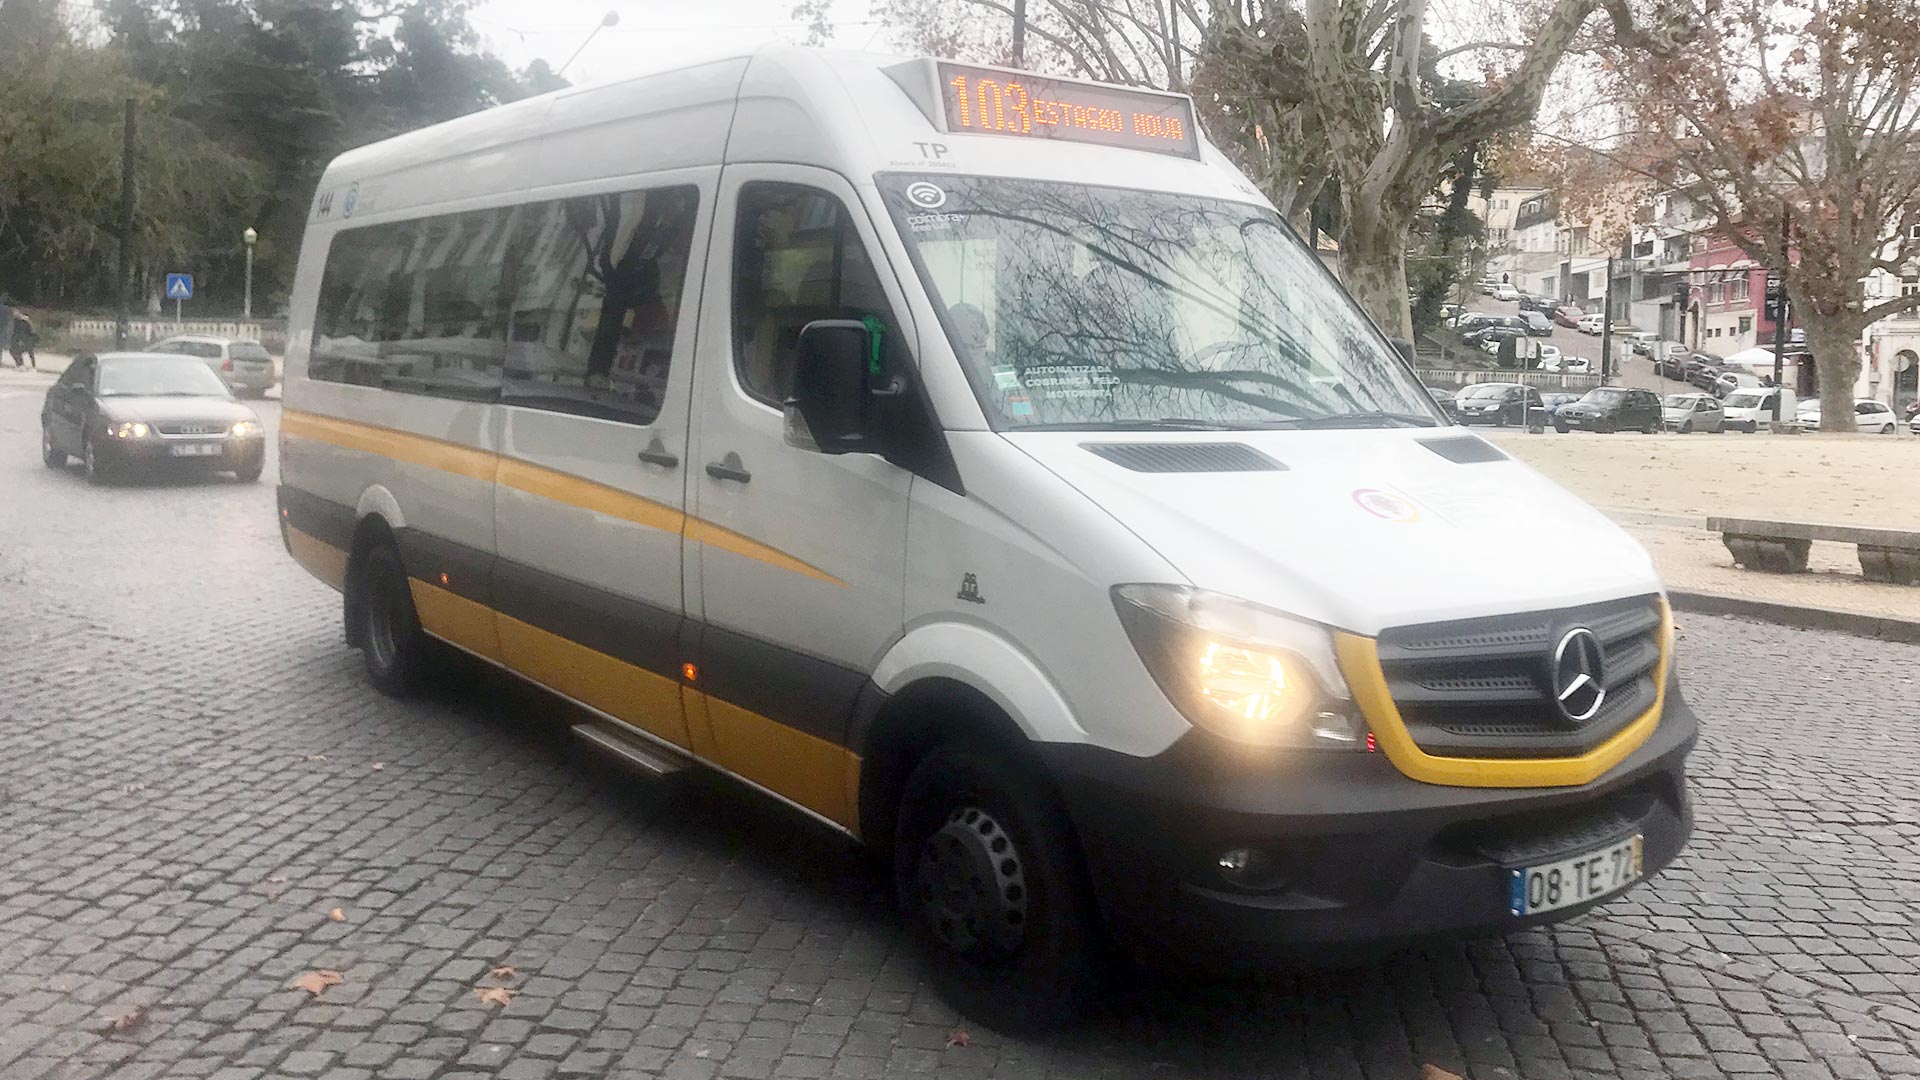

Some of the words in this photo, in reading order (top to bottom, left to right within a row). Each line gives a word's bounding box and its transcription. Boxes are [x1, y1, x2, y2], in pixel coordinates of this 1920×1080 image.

[951, 76, 1031, 133] 103
[1132, 112, 1183, 140] NOVA
[912, 141, 949, 159] TP
[1024, 365, 1113, 375] AUTOMATIZADA
[1092, 376, 1121, 385] PELO
